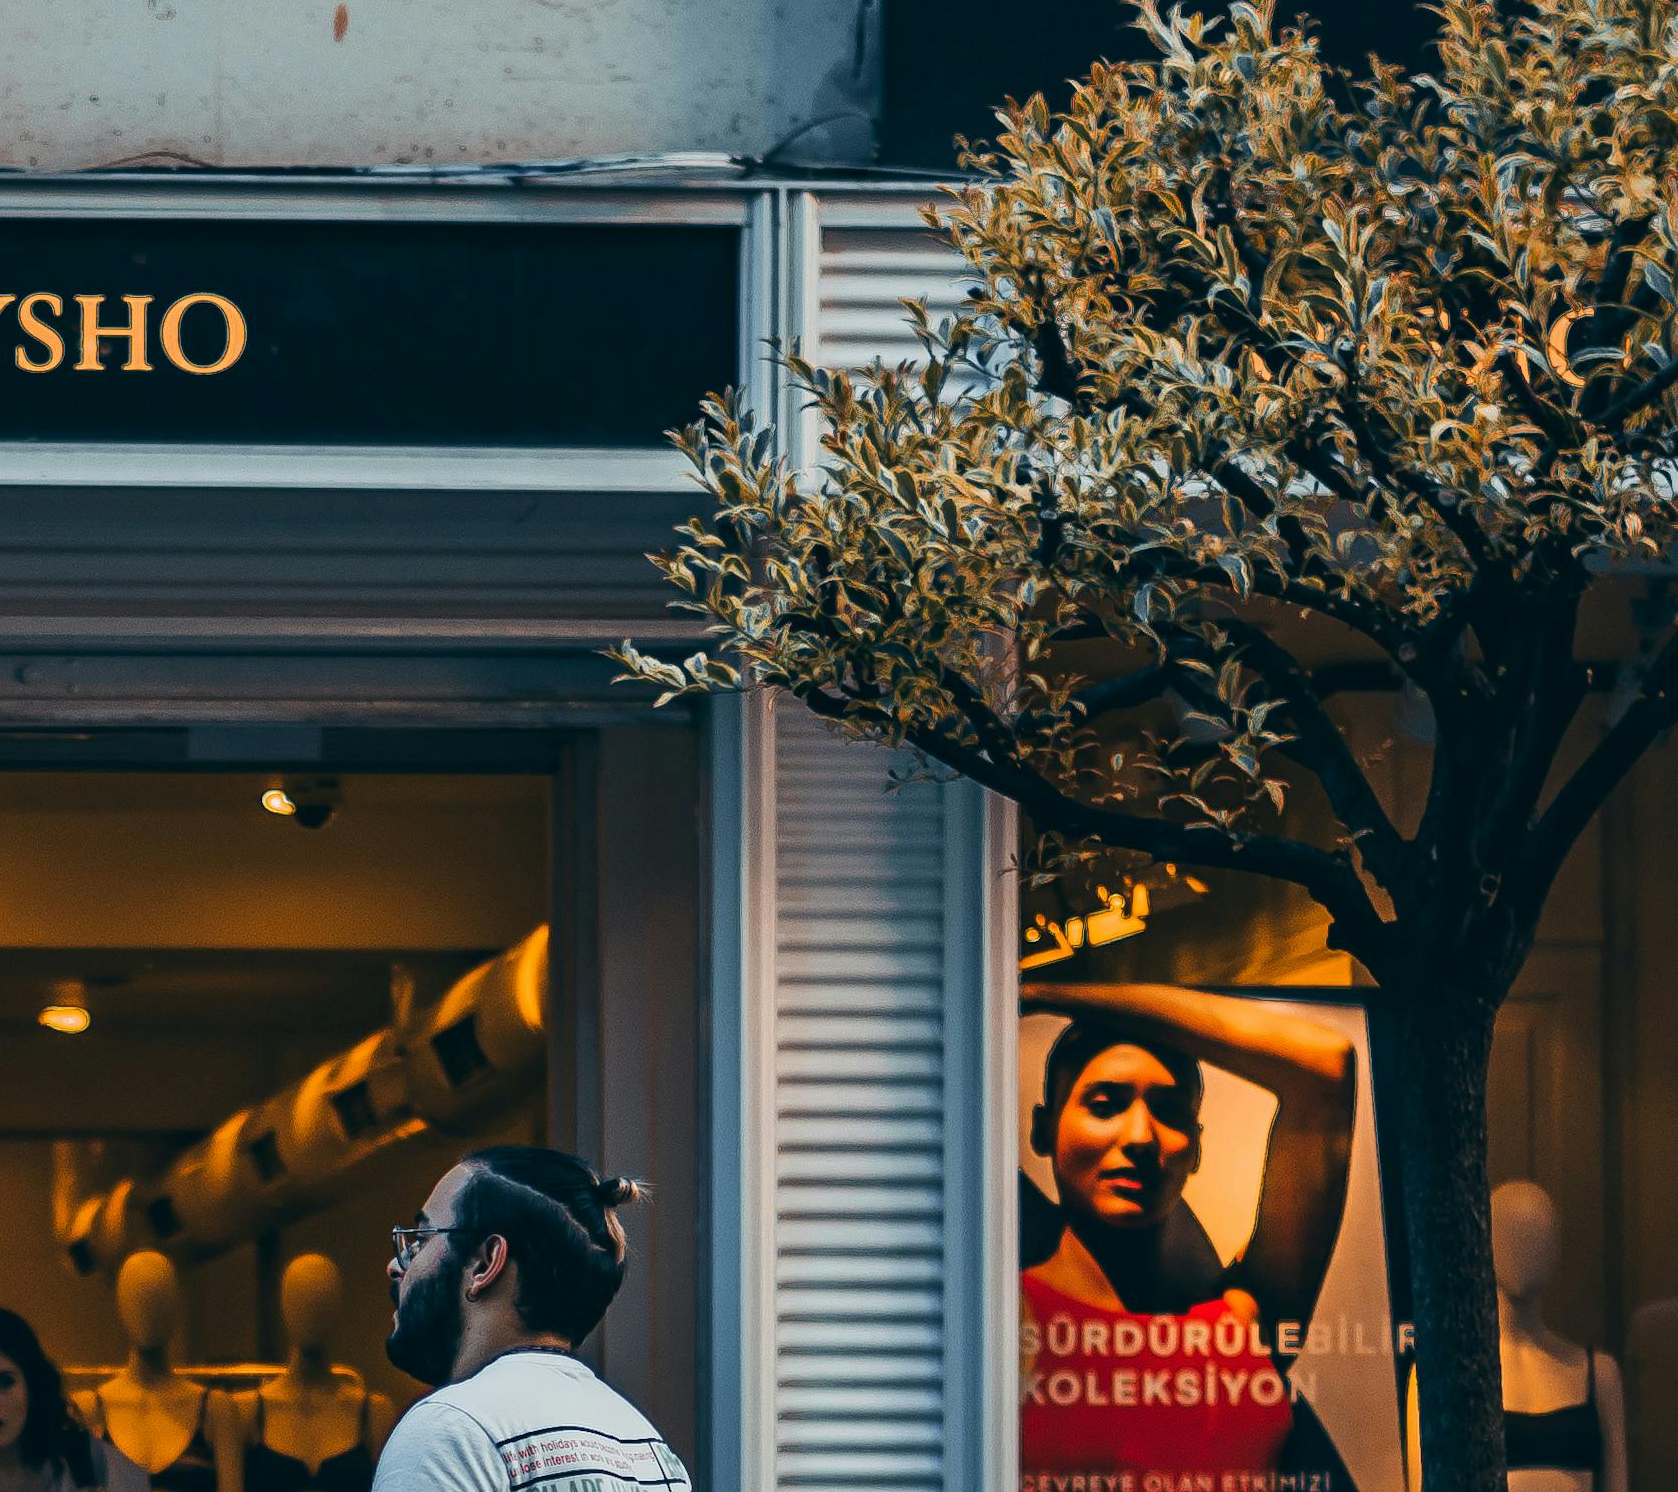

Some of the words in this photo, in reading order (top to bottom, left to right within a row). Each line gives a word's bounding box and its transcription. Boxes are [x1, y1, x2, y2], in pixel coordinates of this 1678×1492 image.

[1024, 1360, 1317, 1407] KOLEKSİYON
[518, 1445, 539, 1459] with
[540, 1439, 578, 1453] holidays
[520, 1459, 541, 1474] lose
[544, 1452, 578, 1468] interest
